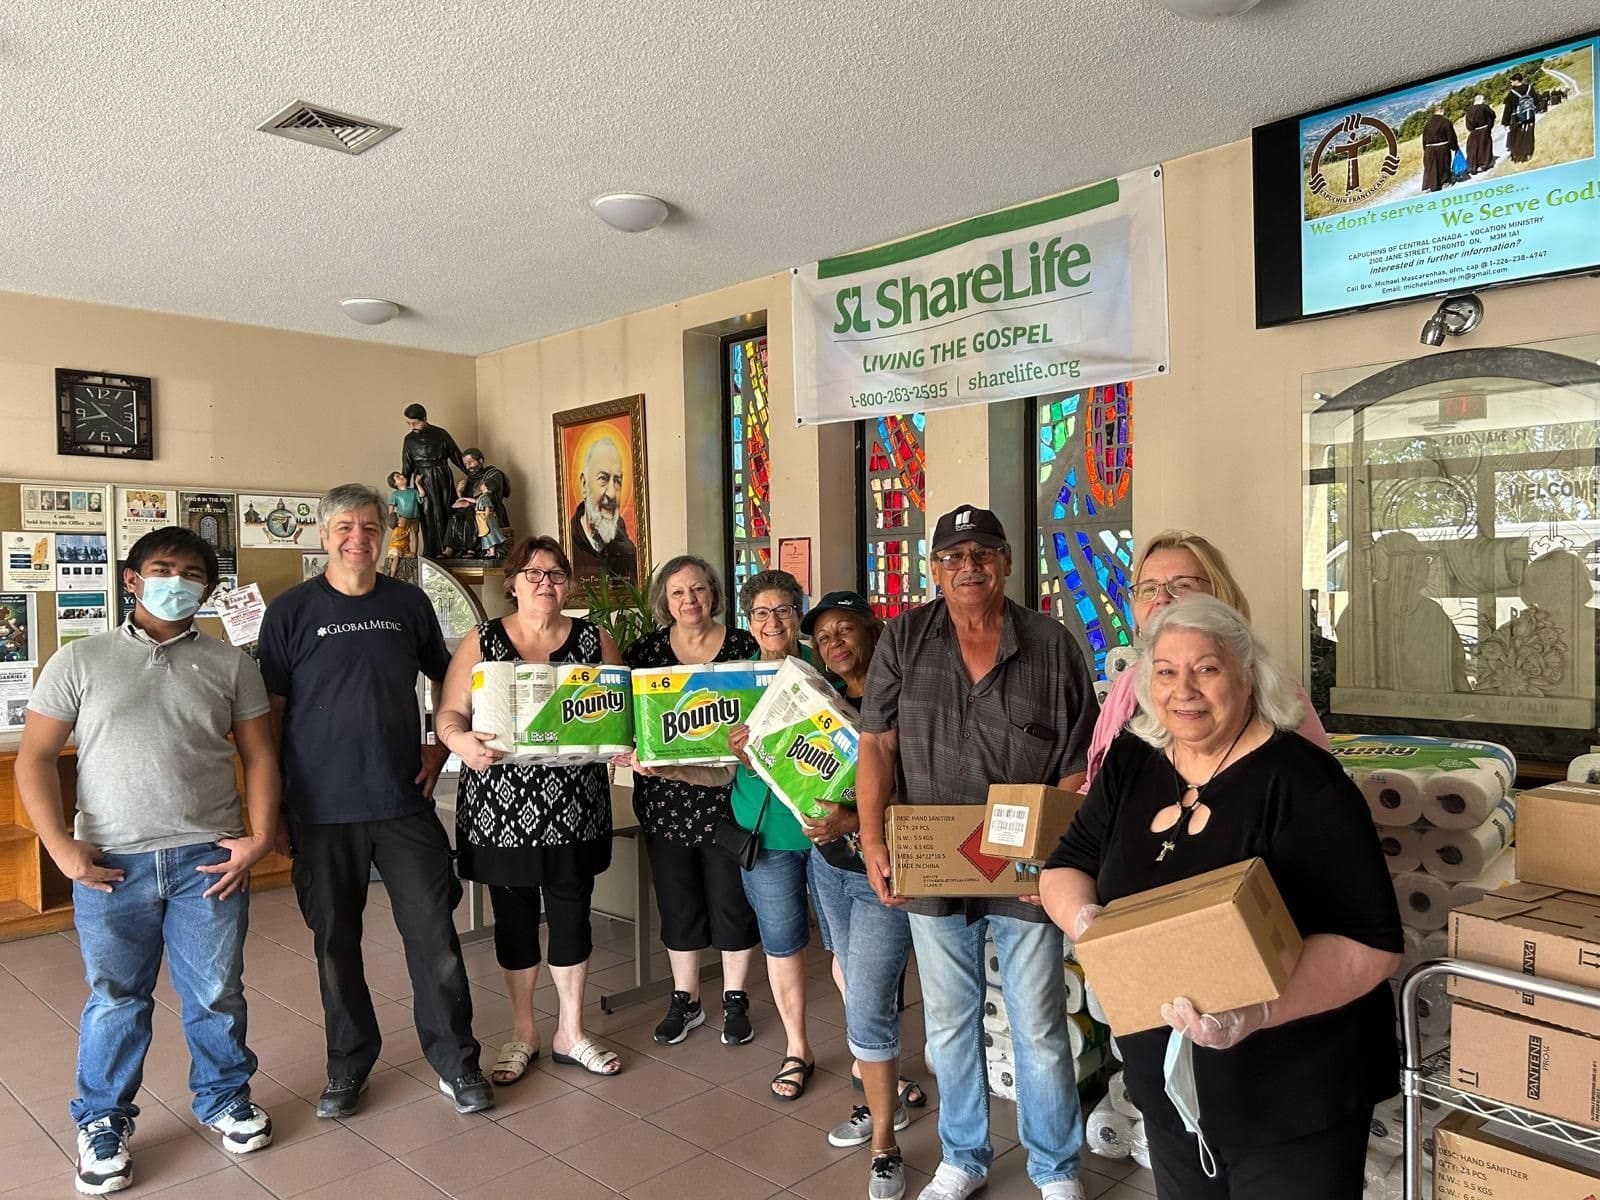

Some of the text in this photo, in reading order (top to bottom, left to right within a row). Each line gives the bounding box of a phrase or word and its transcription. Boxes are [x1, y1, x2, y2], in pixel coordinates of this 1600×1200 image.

[1310, 183, 1530, 235] We don't serve a purpose...
[1440, 209, 1474, 228] We
[1479, 197, 1541, 221] Serve
[1348, 247, 1387, 261] CAPUCHINS
[1388, 245, 1397, 253] OF
[1398, 239, 1430, 250] CENTRAL
[1432, 232, 1462, 244] CANADA
[1470, 224, 1507, 236] VOCATION
[1508, 216, 1544, 228] MINISTRY
[1369, 256, 1383, 265] 2100
[1385, 253, 1402, 262] JANE
[1433, 240, 1465, 252] TORONTO
[1490, 232, 1507, 241] M3M
[1370, 239, 1522, 275] Interested in further information?
[1375, 277, 1400, 287] Michael
[1466, 264, 1479, 272] cap
[1481, 261, 1488, 269] @
[1489, 250, 1547, 266] 1-226-238-4747
[876, 237, 1092, 329] ShareLife
[863, 323, 1053, 374] LIVING THE GOSPEL
[98, 389, 110, 400] 12
[849, 359, 1081, 408] 1-800-263-2595 sharelife.org
[75, 408, 134, 422] 9 3
[100, 431, 111, 442] 6
[327, 620, 402, 635] GLOBALMEDIC
[562, 690, 625, 723] Bounty
[662, 696, 740, 744] Bounty
[786, 734, 841, 780] Bounty
[1528, 1036, 1541, 1099] PANTENE
[1460, 1154, 1485, 1167] HAND
[1486, 1162, 1528, 1180] SANITIZER
[1472, 1170, 1488, 1181] PCS
[1463, 1181, 1476, 1191] 5.5
[1477, 1186, 1494, 1196] KGS
